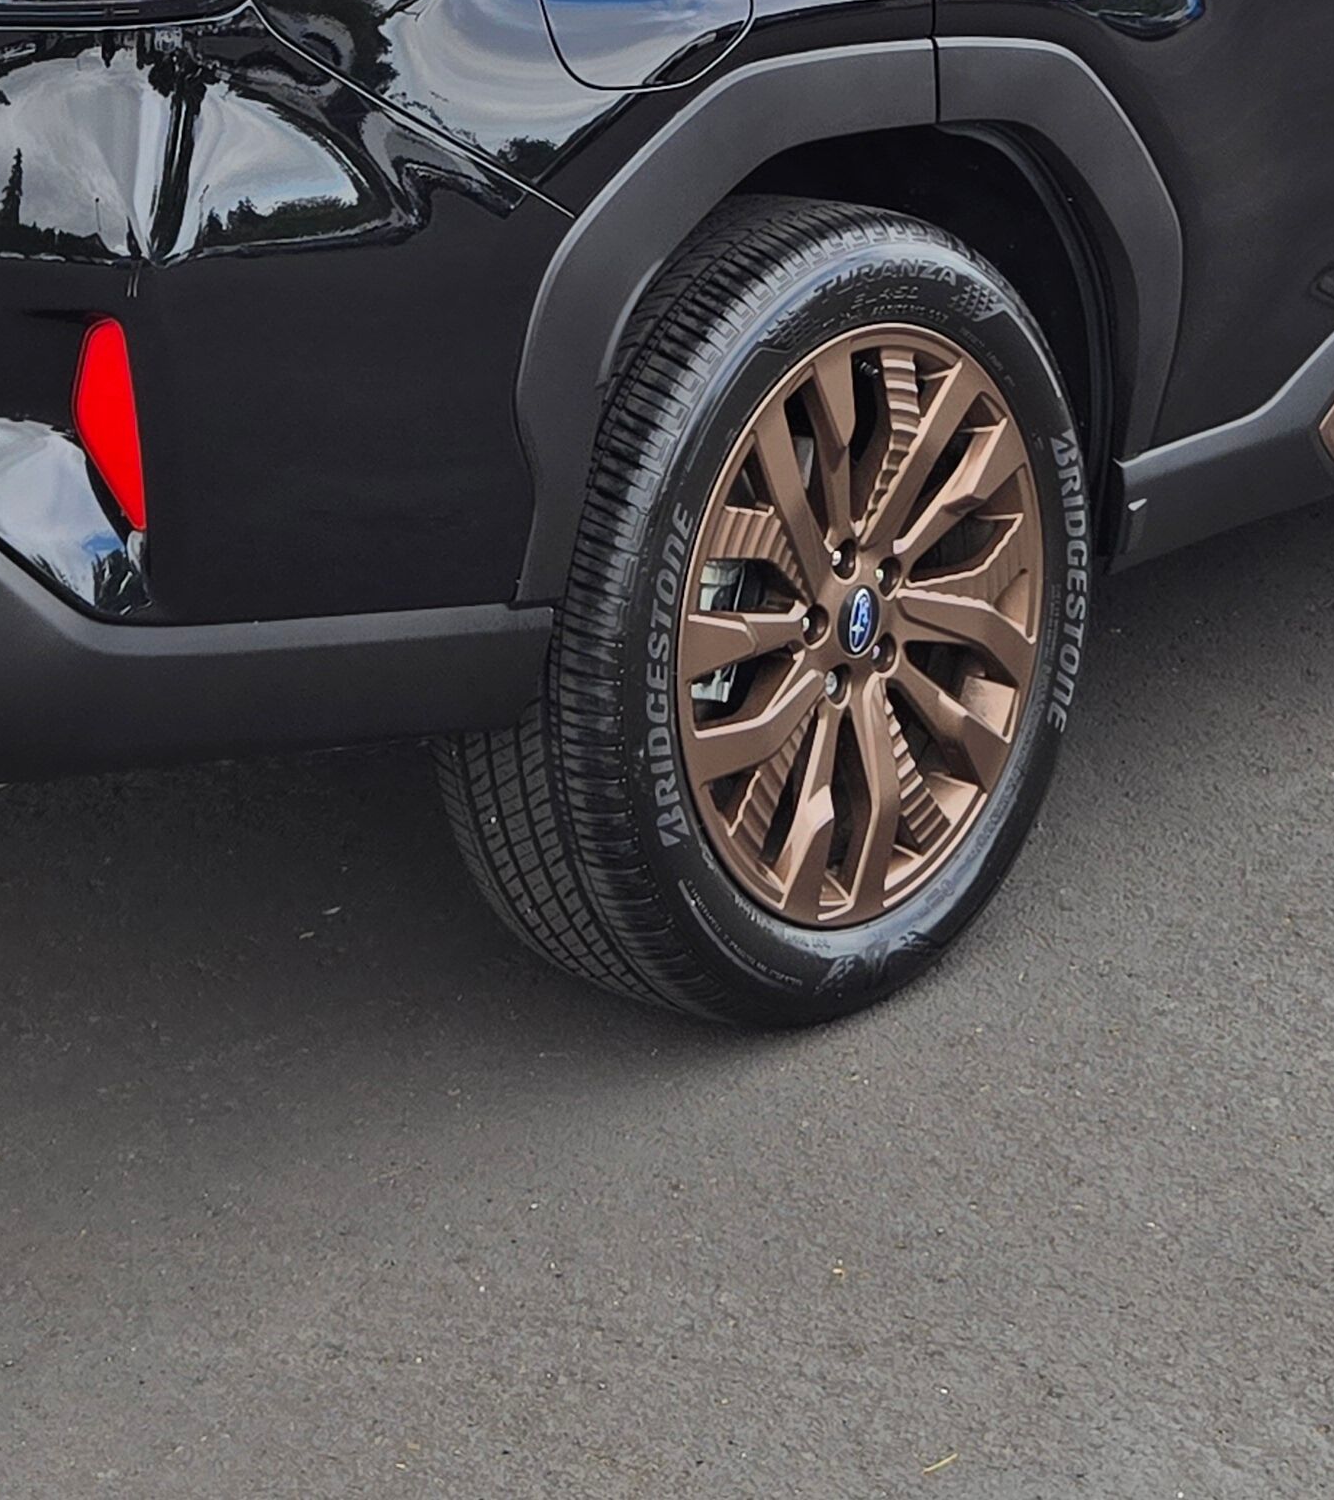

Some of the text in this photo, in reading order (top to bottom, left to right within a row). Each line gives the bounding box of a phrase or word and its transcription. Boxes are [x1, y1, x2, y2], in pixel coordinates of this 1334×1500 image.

[813, 258, 958, 304] TURANZA
[645, 501, 695, 848] BRIDGESTONE
[1047, 427, 1088, 734] BRIDGESTONE
